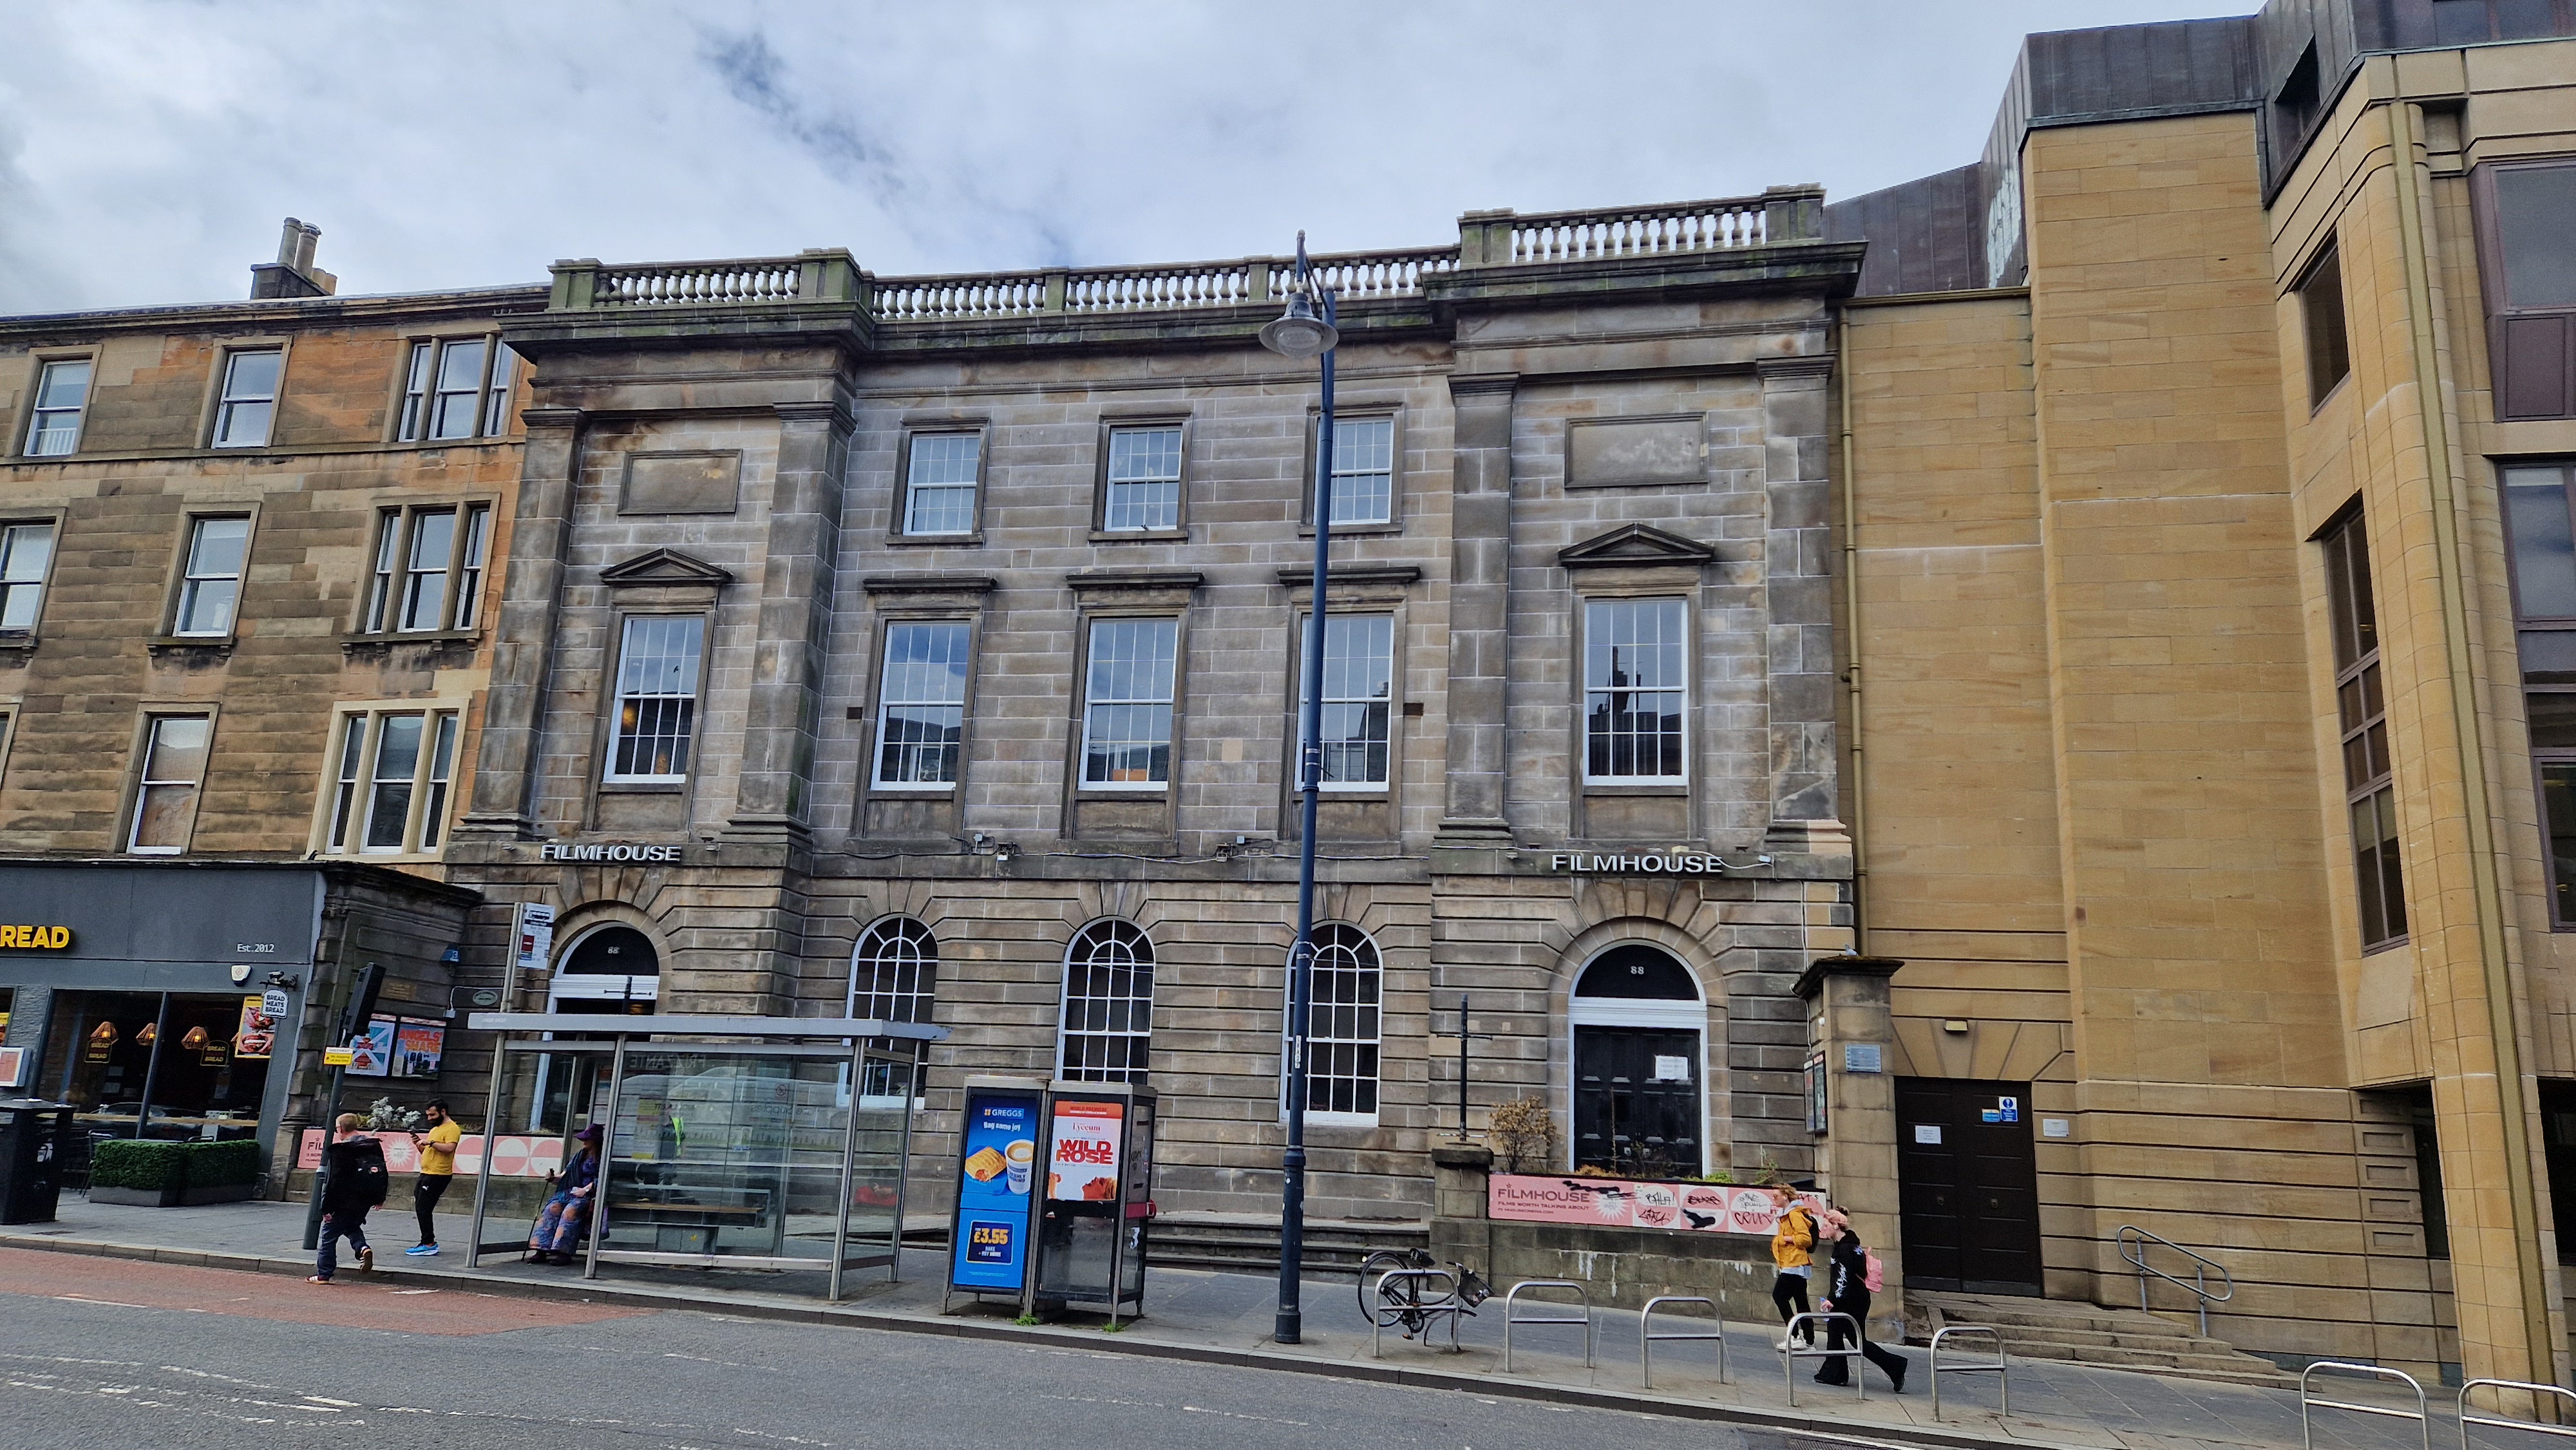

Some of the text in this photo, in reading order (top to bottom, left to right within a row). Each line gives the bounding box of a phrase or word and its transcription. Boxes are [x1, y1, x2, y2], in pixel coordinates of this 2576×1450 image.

[540, 844, 681, 862] FILMHOUSE
[1551, 854, 1723, 873] FILMHOUSE
[236, 943, 275, 953] Est.2012
[1630, 966, 1645, 975] 88
[404, 1040, 442, 1053] SHARE
[992, 1109, 1023, 1117] GREGGS
[983, 1122, 995, 1130] Bag
[1012, 1123, 1021, 1132] joy
[1059, 1139, 1112, 1153] WILD
[1056, 1149, 1113, 1165] ROSE
[1498, 1188, 1590, 1203] FILMHOUSE
[974, 1228, 1009, 1245] £3.55
